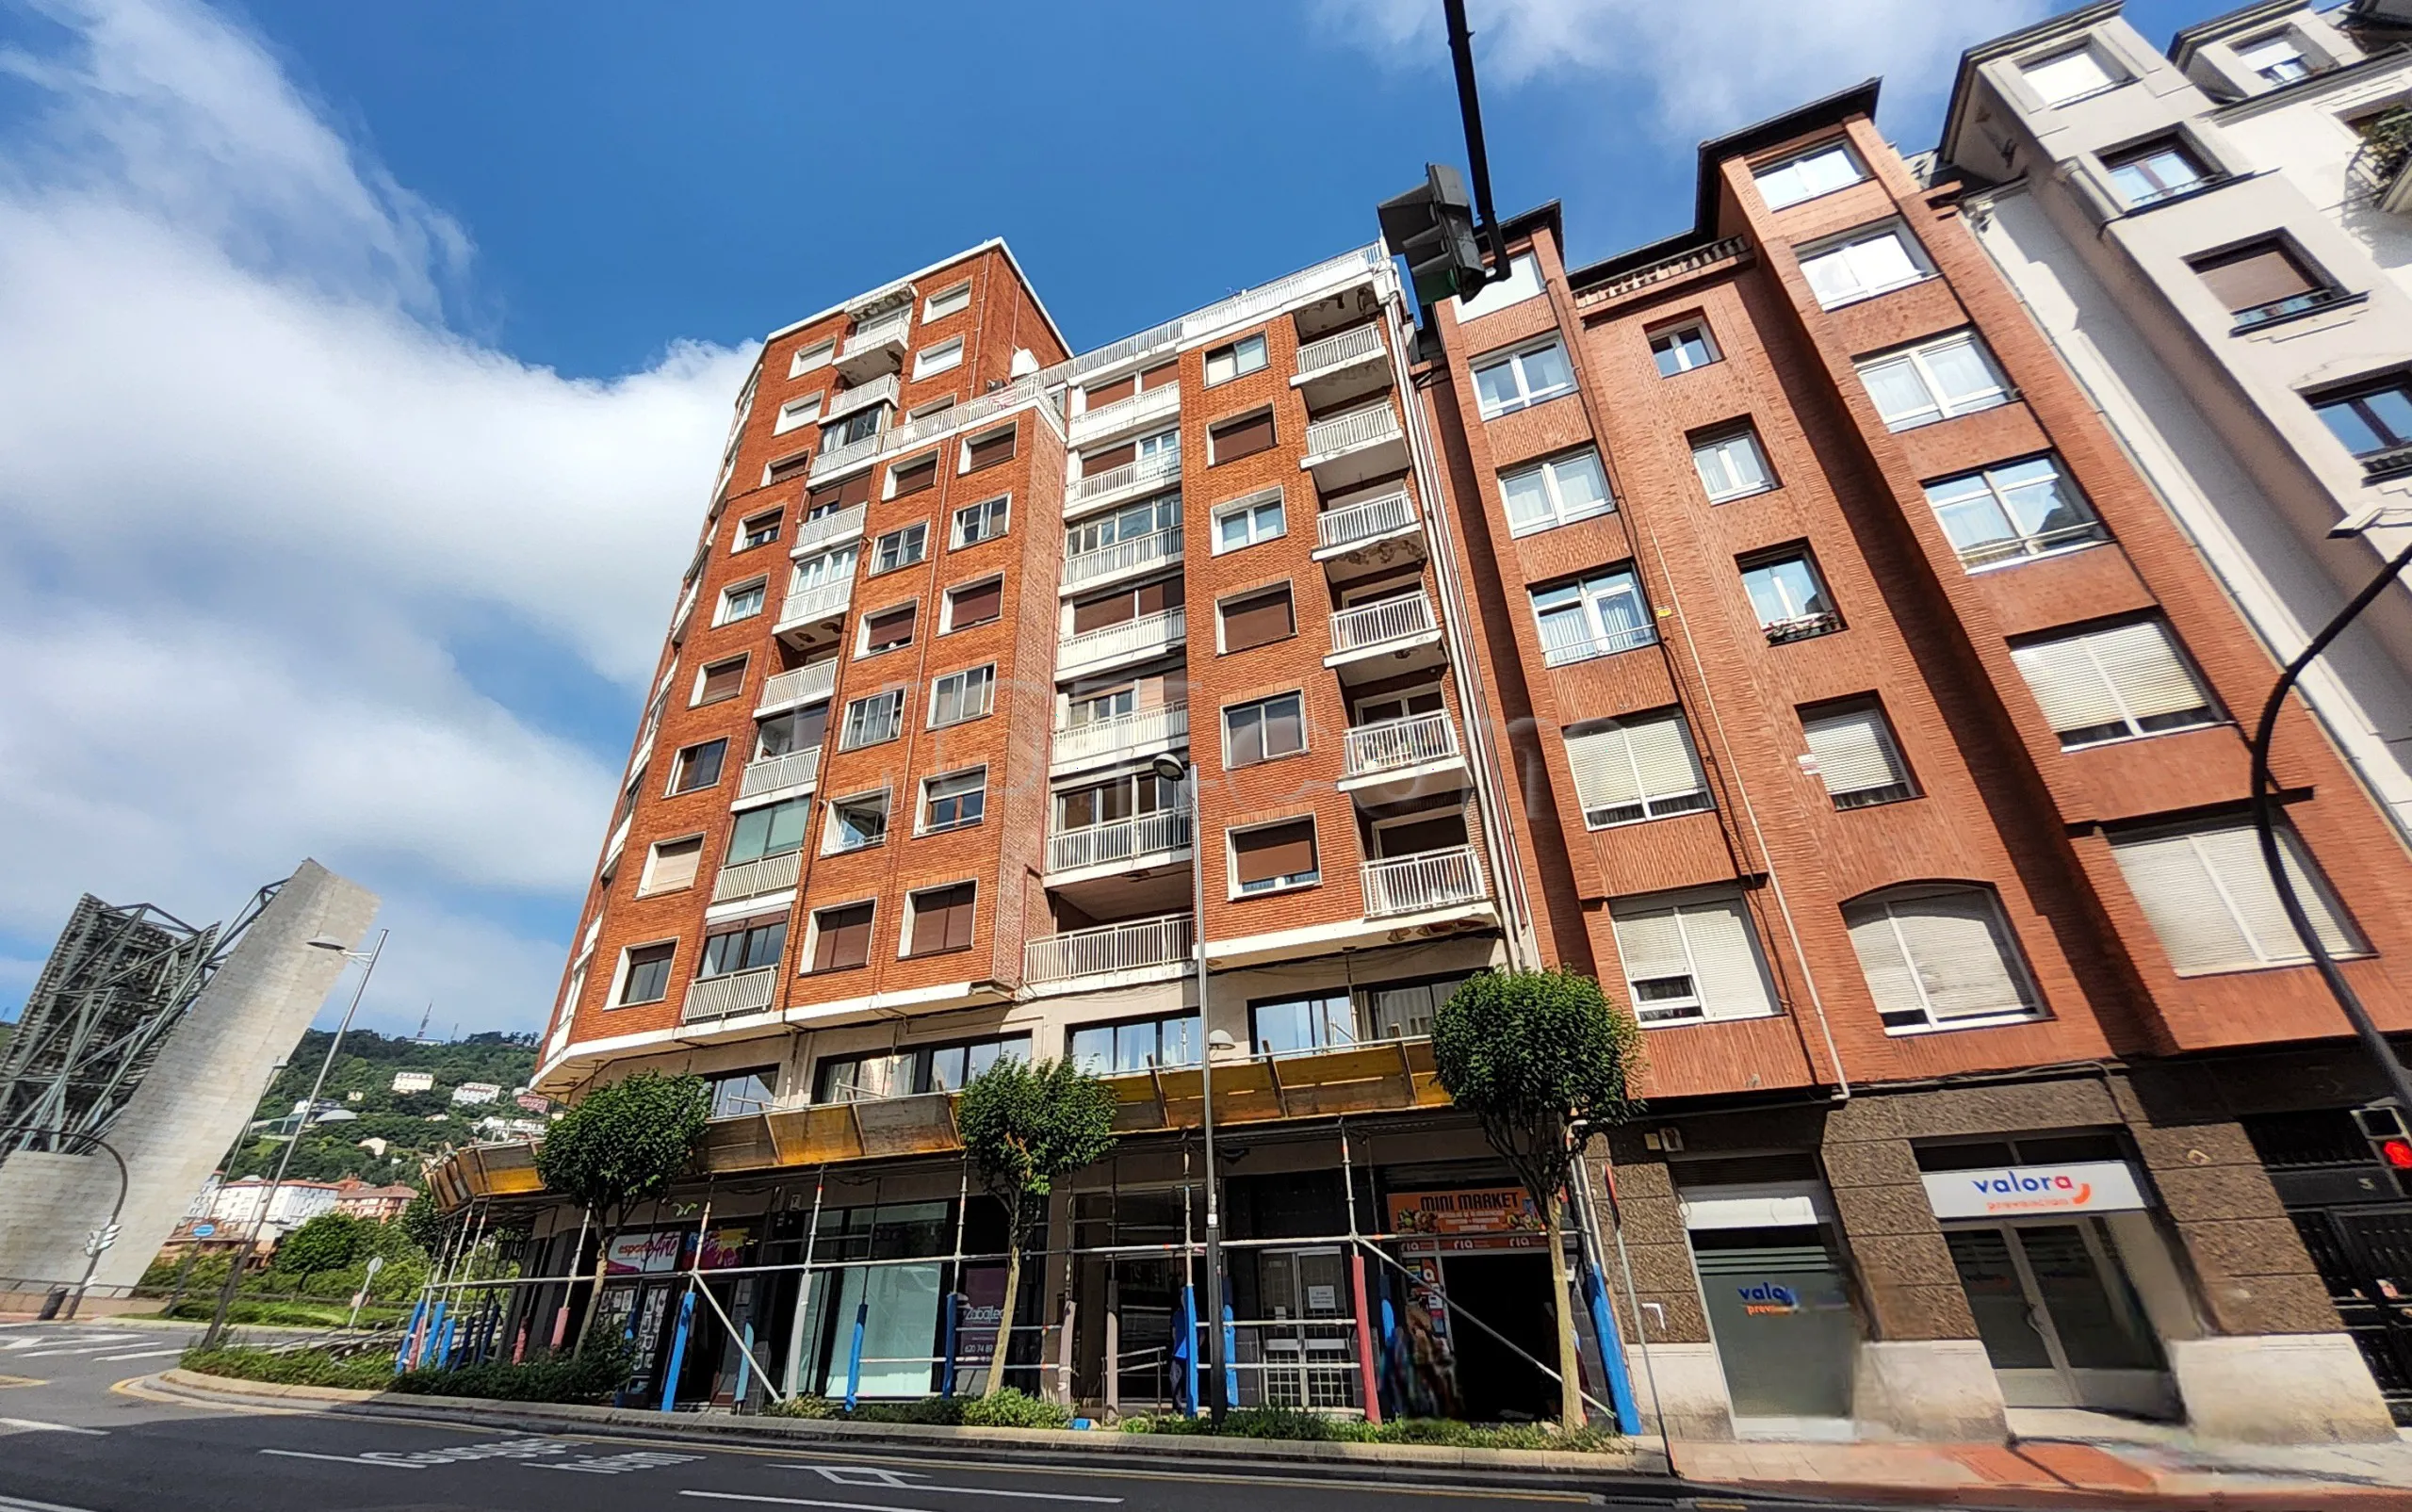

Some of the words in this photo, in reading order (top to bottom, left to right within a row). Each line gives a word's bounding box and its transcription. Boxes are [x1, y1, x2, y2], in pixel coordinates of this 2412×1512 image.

[1971, 1171, 2075, 1194] valora
[1420, 1195, 1455, 1211] MINI
[1458, 1192, 1519, 1211] MARKET
[1453, 1240, 1474, 1250] ria
[1508, 1237, 1530, 1247] ria
